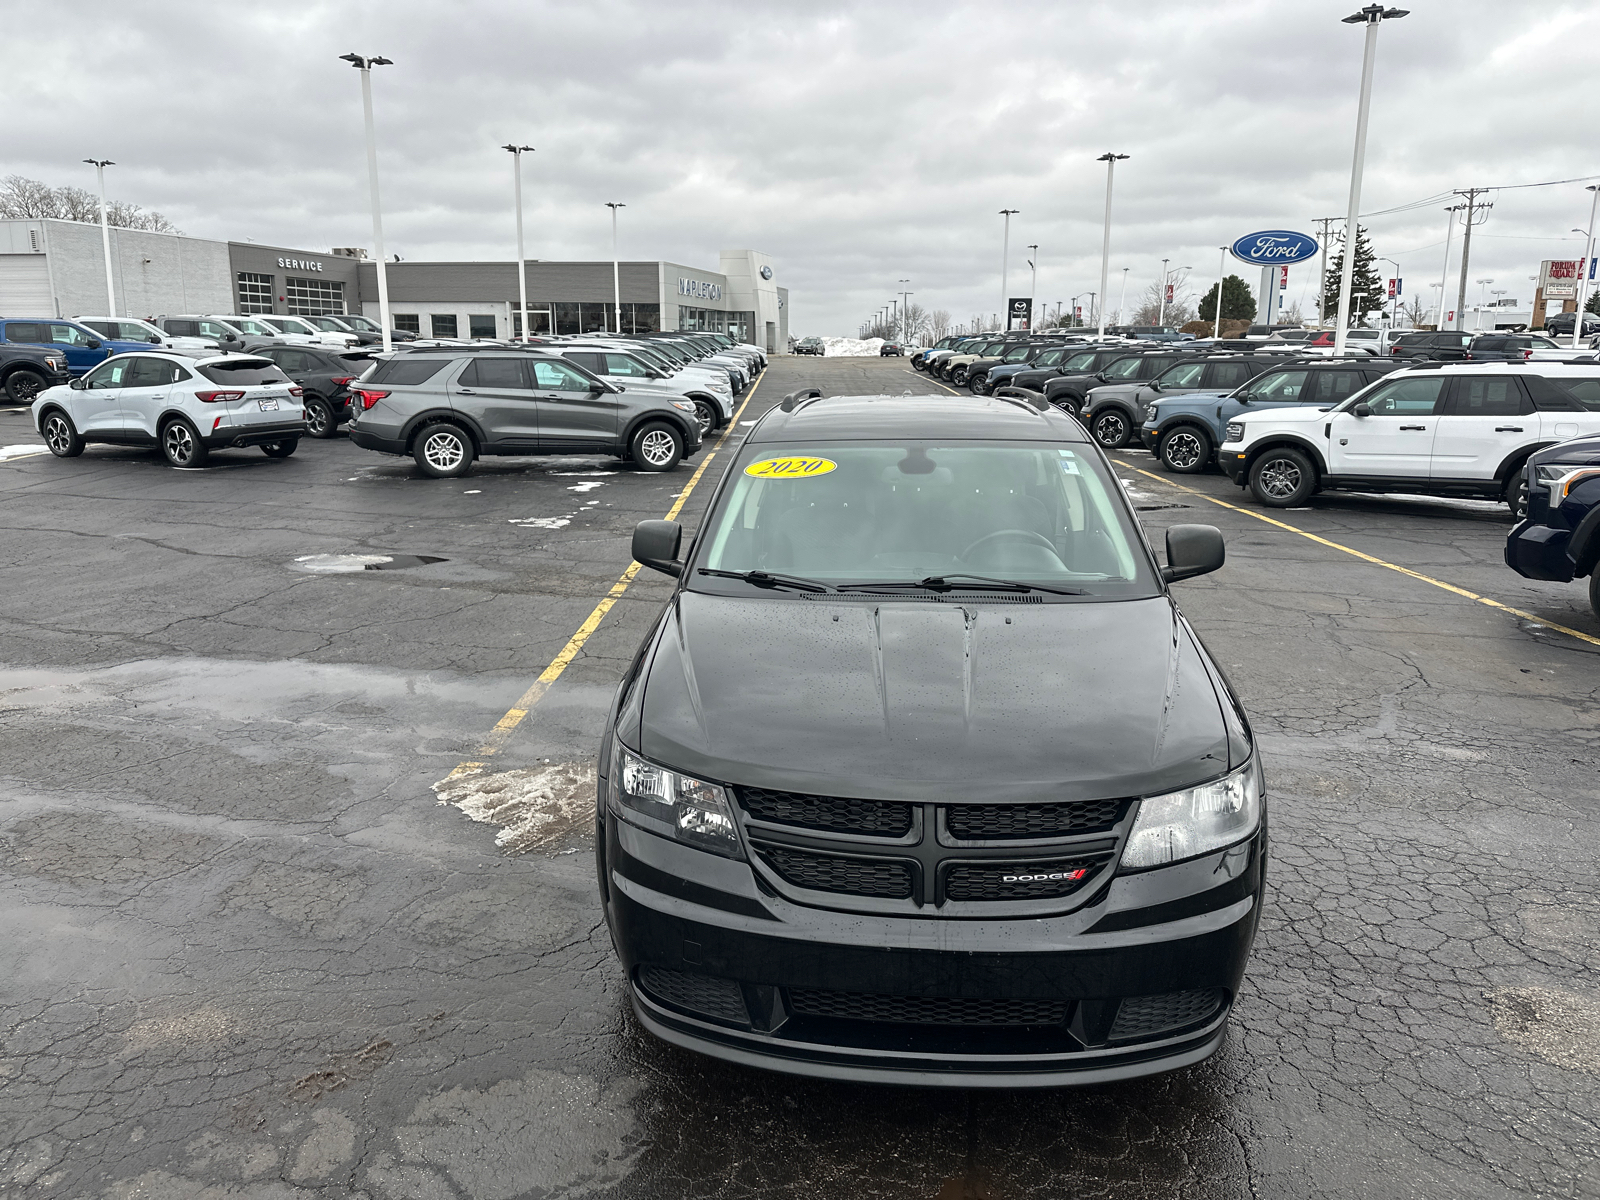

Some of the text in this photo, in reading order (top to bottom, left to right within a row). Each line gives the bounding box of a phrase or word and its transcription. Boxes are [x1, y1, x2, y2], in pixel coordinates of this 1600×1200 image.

[1250, 236, 1302, 257] Ford
[278, 257, 323, 272] SERVICE
[1551, 261, 1576, 270] FORUM
[1548, 270, 1576, 279] SQUARE
[678, 277, 722, 300] NAPLETON
[757, 460, 823, 475] 2020
[1003, 871, 1077, 882] DODGE
